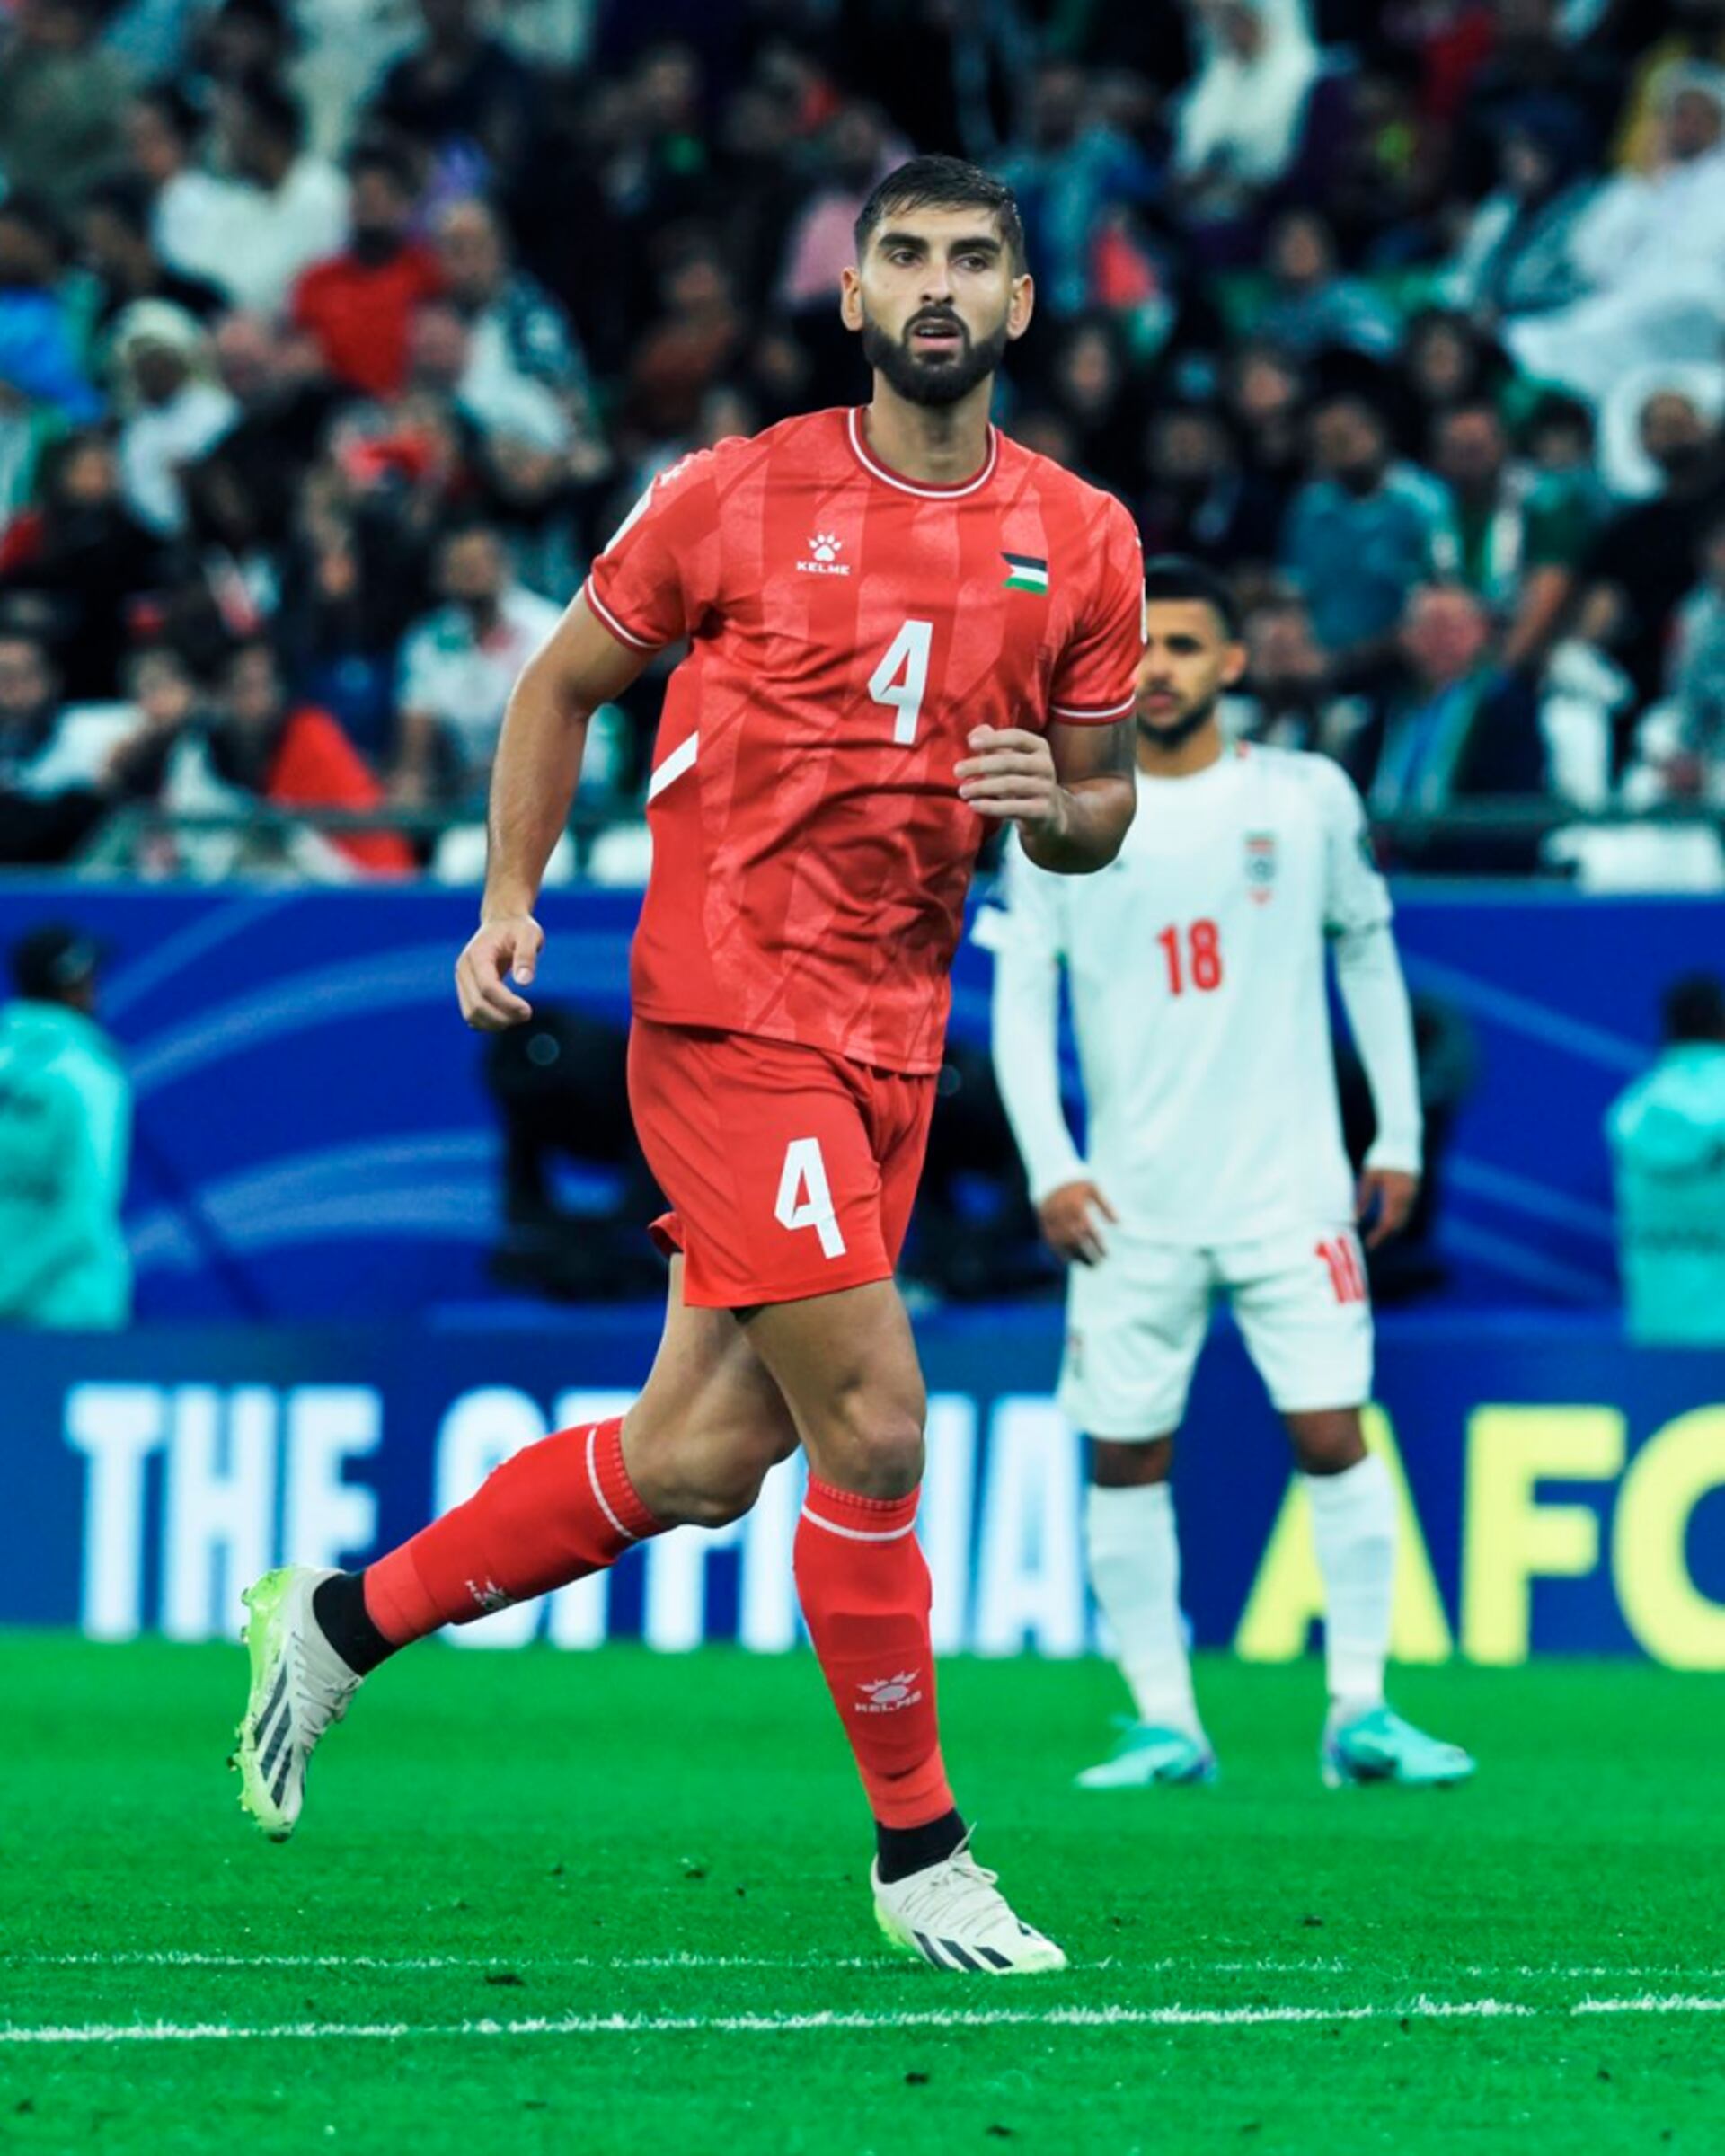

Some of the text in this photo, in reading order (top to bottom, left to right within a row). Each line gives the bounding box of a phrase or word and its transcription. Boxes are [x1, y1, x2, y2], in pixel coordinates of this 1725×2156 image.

[796, 561, 851, 576] KELME
[867, 619, 933, 745] 4
[1157, 918, 1223, 996] 18
[774, 1136, 847, 1259] 4
[64, 1382, 384, 1643] THE
